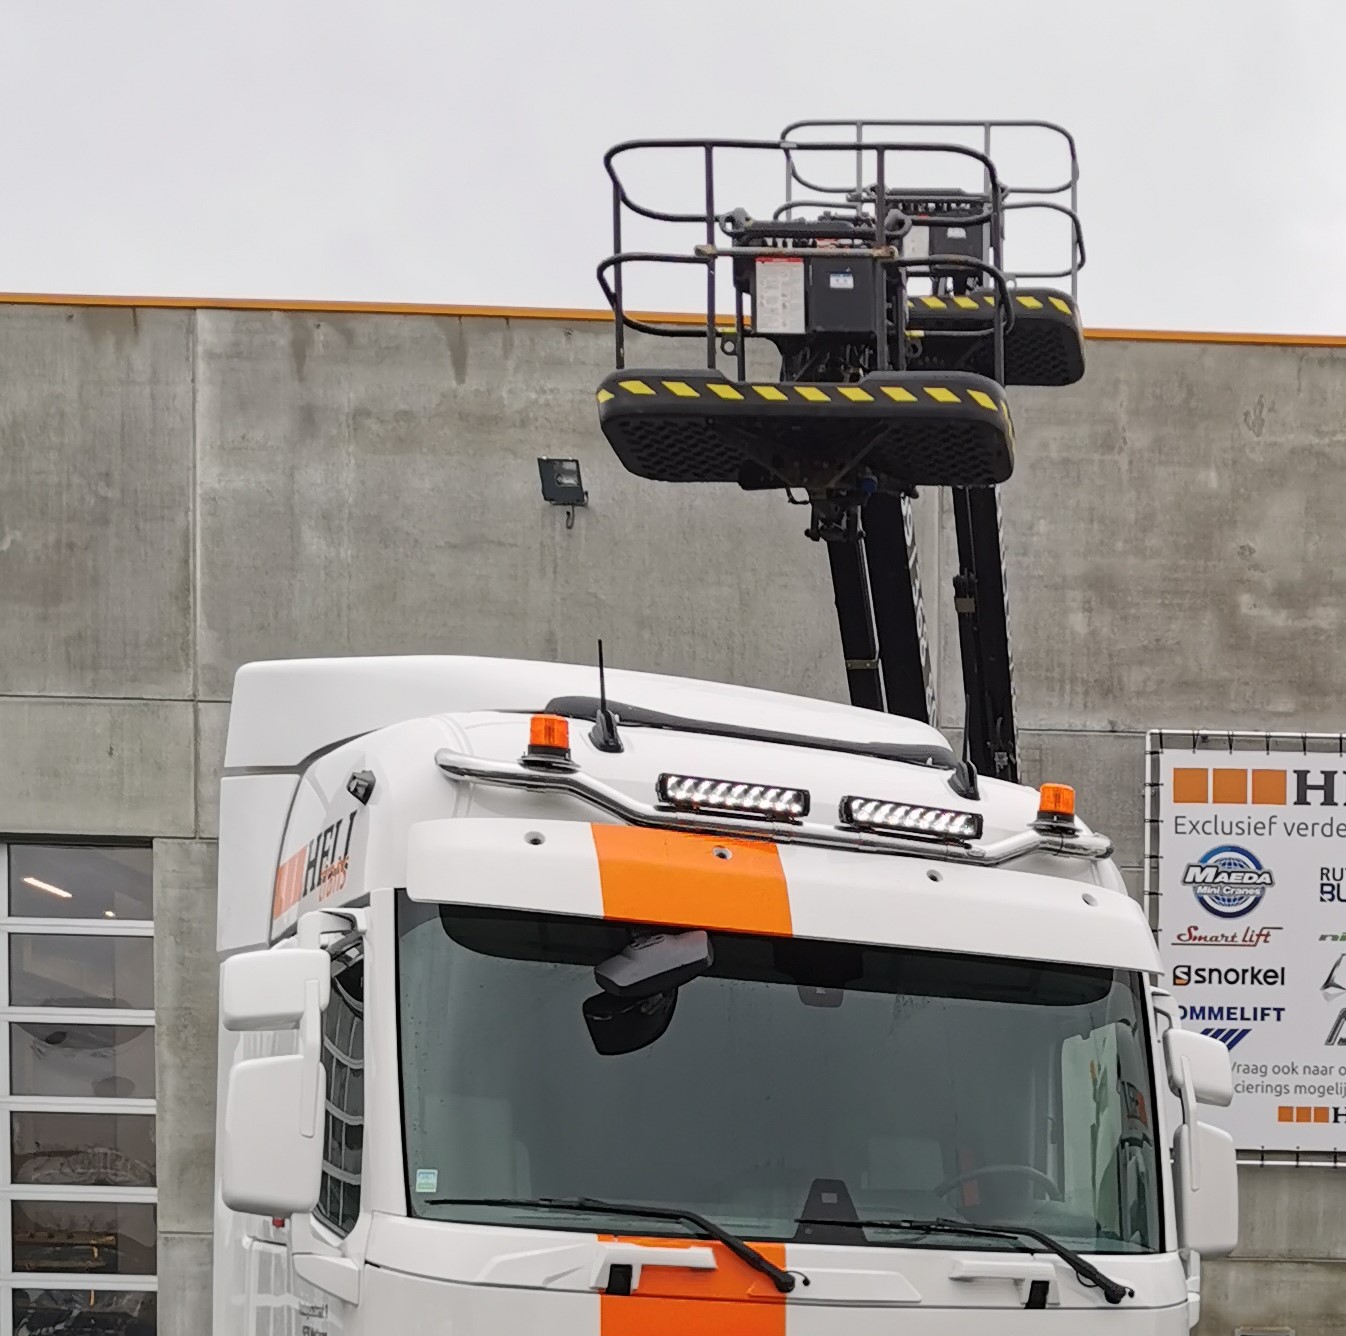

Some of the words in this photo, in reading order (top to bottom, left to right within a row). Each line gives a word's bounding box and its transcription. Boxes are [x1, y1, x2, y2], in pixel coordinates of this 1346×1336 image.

[1174, 815, 1278, 837] Exclusief
[302, 810, 358, 898] HELI
[1183, 865, 1273, 885] MAEDA
[1196, 886, 1219, 895] Mini
[1222, 886, 1261, 896] Cranes
[1176, 925, 1239, 944] Smart
[1194, 966, 1286, 986] snorkel
[1272, 1062, 1299, 1075] ook
[1302, 1065, 1335, 1076] naar
[1234, 1080, 1290, 1097] cierings
